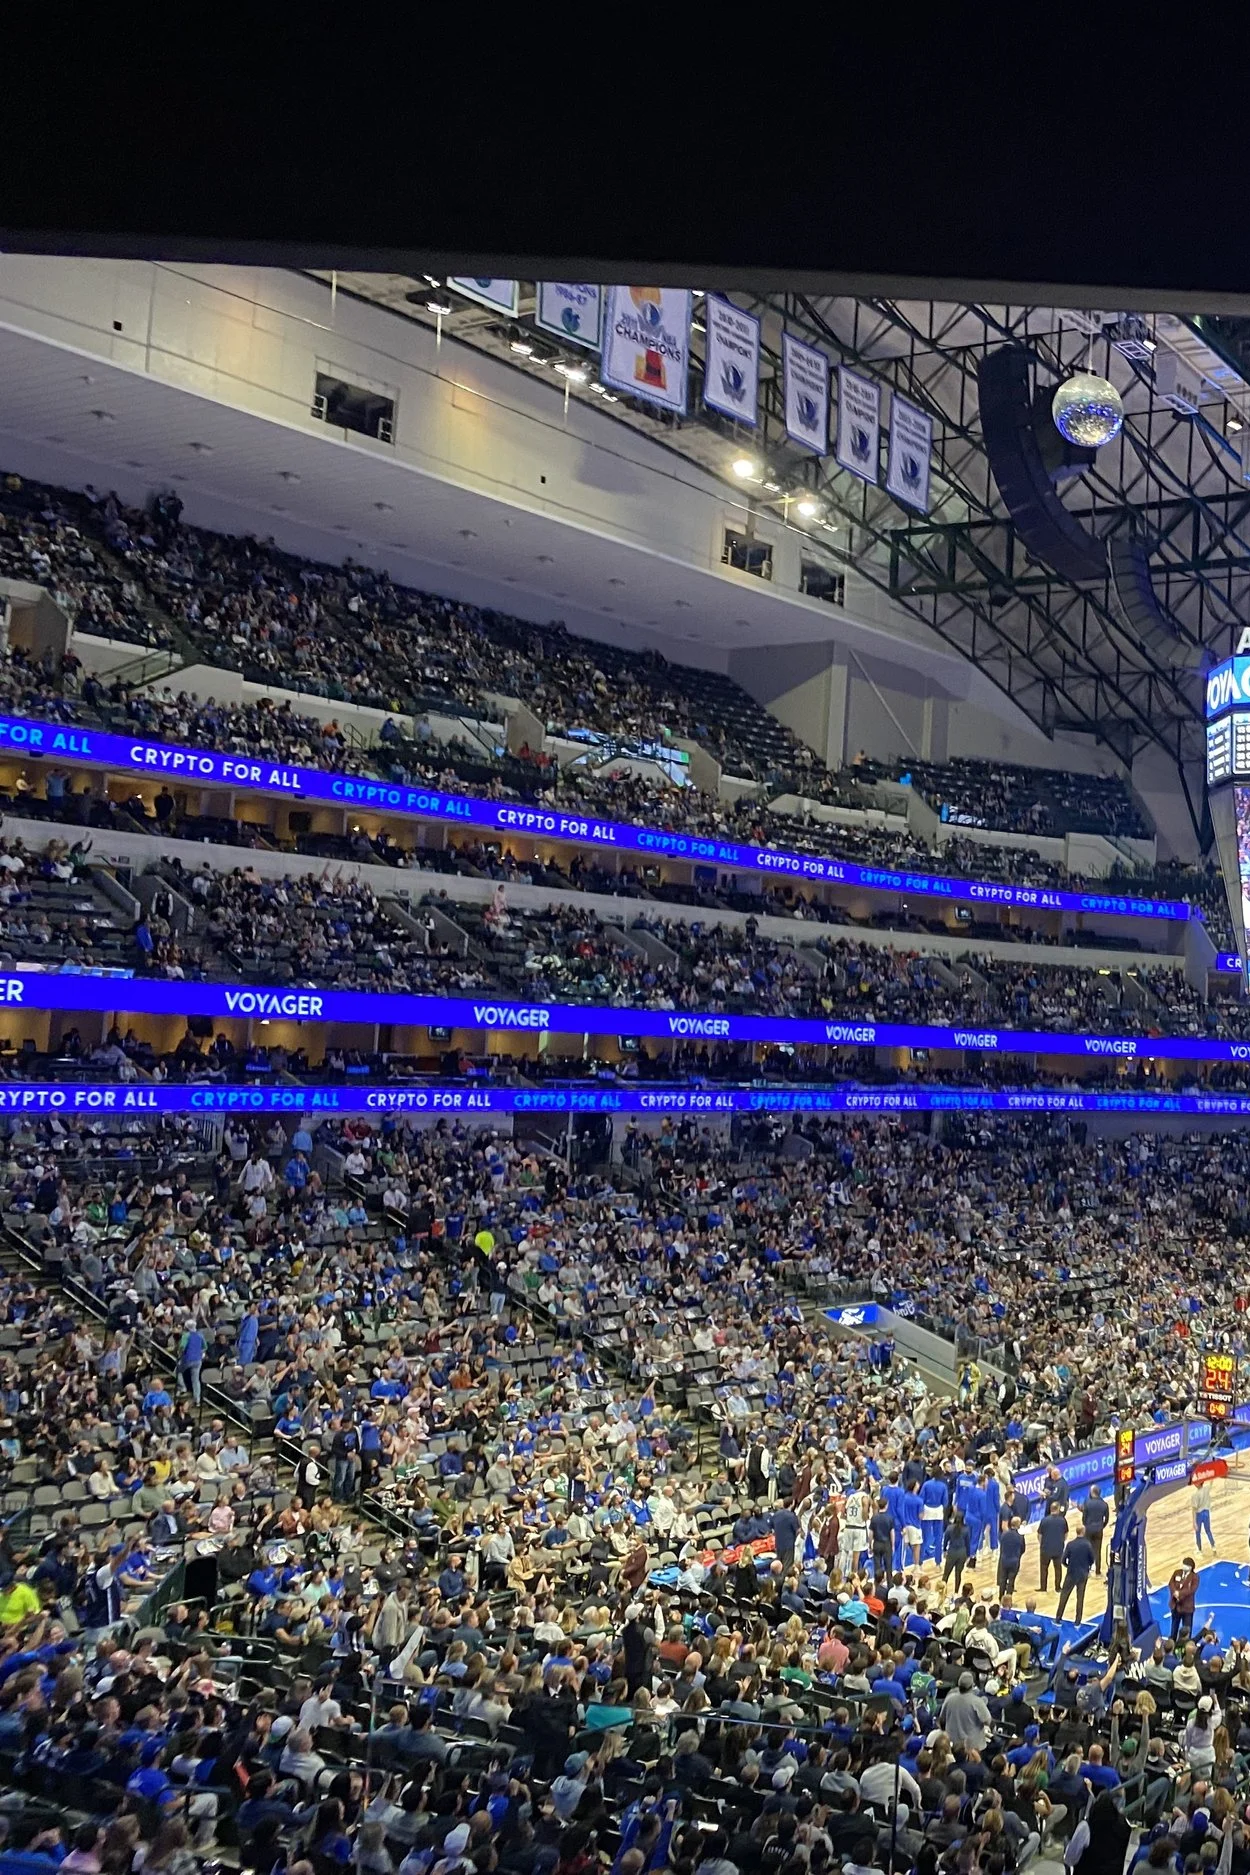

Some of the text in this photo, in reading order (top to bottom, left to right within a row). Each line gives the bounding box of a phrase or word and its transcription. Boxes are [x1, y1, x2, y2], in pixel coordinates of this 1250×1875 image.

[615, 324, 681, 362] CHAMPIONS
[0, 723, 91, 752] FOR ALL
[130, 746, 300, 788] CRYPTO FOR ALL
[332, 781, 471, 816] CRYPTO FOR ALL
[497, 809, 615, 840] CRYPTO FOR ALL
[637, 833, 738, 860] CRYPTO FOR ALL
[757, 853, 844, 878] CRYPTO FOR ALL
[860, 871, 951, 892] CRYPTO FOR ALL
[970, 885, 1061, 905] CRYPTO FOR ALL
[1081, 896, 1175, 915] CRYPTO FOR ALL
[225, 992, 322, 1014] VOYAGER
[474, 1006, 549, 1026] VOYAGER
[669, 1017, 729, 1034] VOYAGER
[826, 1026, 875, 1041] VOYAGER
[954, 1033, 996, 1046] VOYAGER
[1085, 1039, 1136, 1052] VOYAGER
[74, 1091, 114, 1105] FOR
[123, 1091, 156, 1106] ALL
[367, 1093, 490, 1106] CRYPTO FOR ALL
[640, 1094, 733, 1106] CRYPTO FOR ALL
[846, 1095, 916, 1106] CRYPTO FOR ALL
[1008, 1095, 1083, 1107] CRYPTO FOR ALL
[1197, 1099, 1236, 1110] CRYPTO
[1205, 1369, 1230, 1390] 24
[1208, 1391, 1232, 1402] TISSOT
[1145, 1432, 1181, 1454] VOYAGER
[1063, 1459, 1099, 1480] CRYPTO
[1157, 1463, 1187, 1480] VOYAGER
